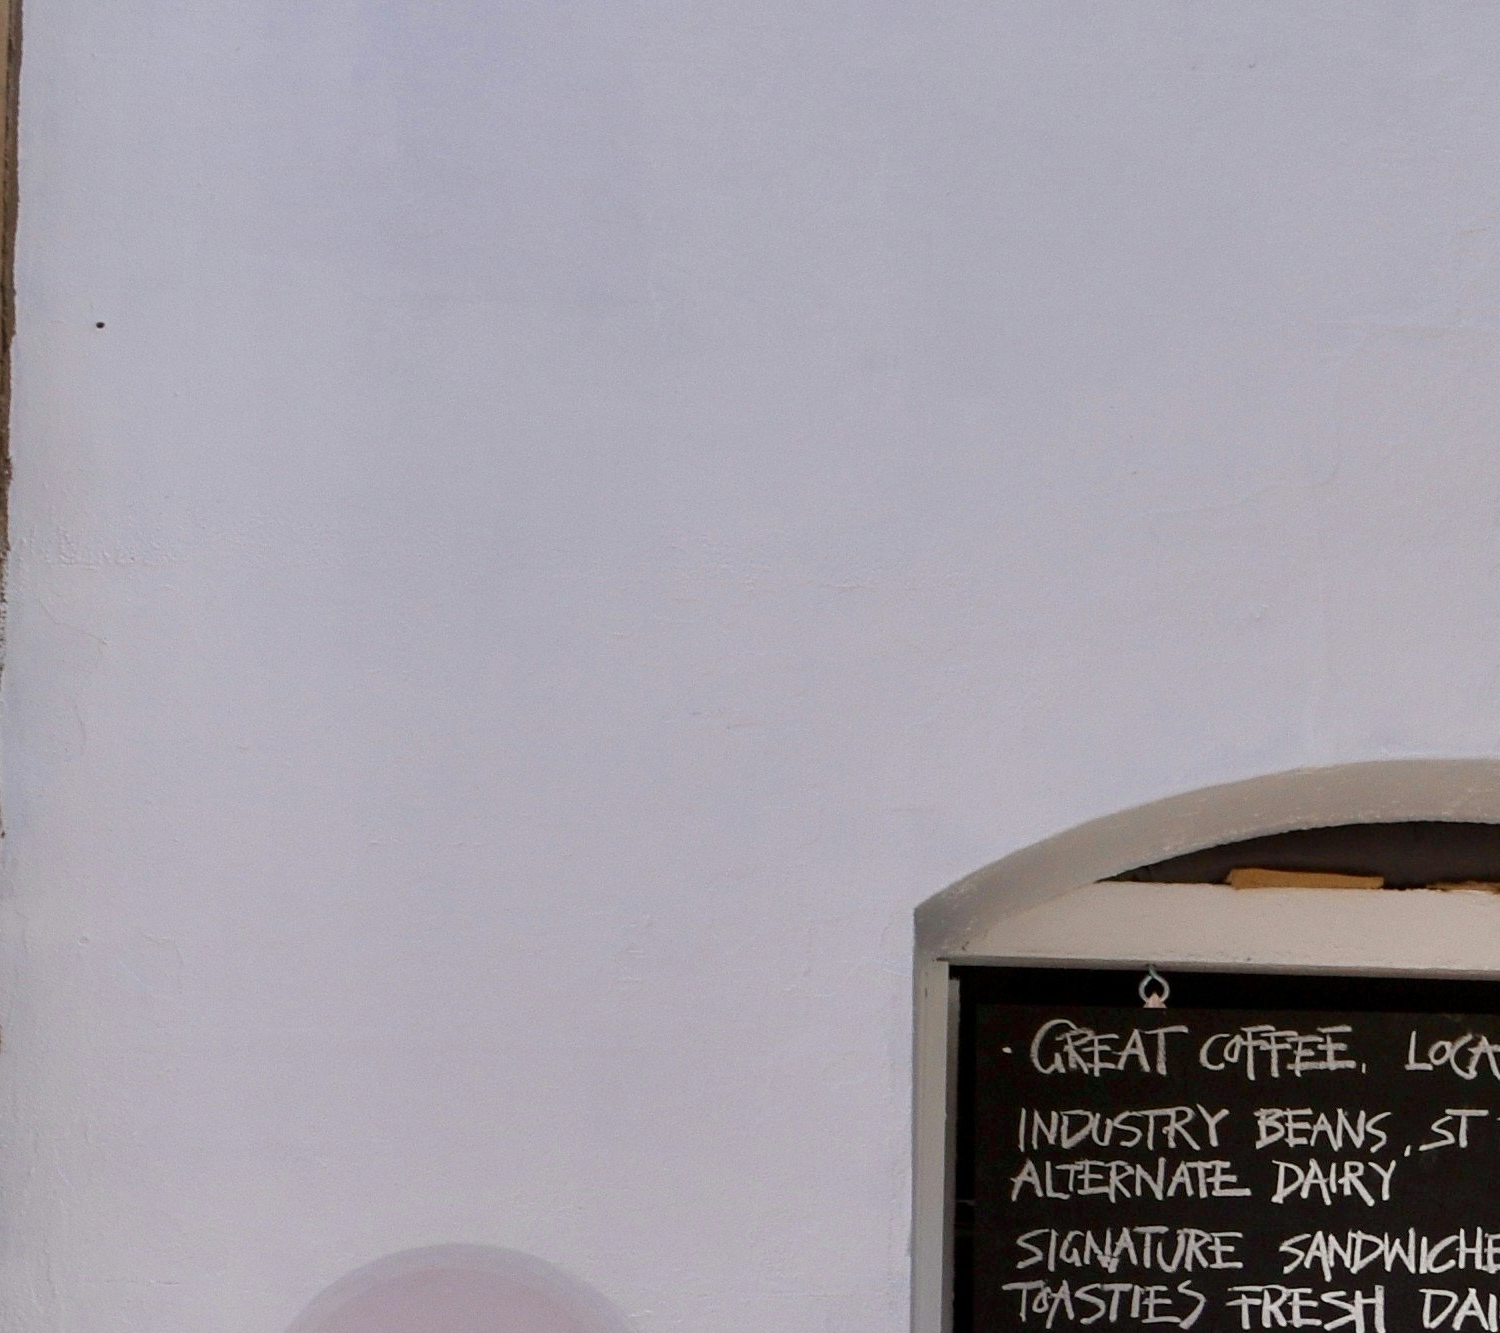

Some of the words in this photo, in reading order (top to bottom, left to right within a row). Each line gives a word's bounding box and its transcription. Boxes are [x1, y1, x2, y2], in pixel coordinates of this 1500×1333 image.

[1030, 1019, 1189, 1077] GREAT
[1017, 1103, 1230, 1152] INDUSTRY
[1418, 1108, 1490, 1152] ST
[1010, 1156, 1252, 1204] ALTERNATE
[1270, 1158, 1397, 1207] DAIRY
[1015, 1225, 1244, 1274] SIGNATURE
[1001, 1279, 1208, 1330] TOASTIES
